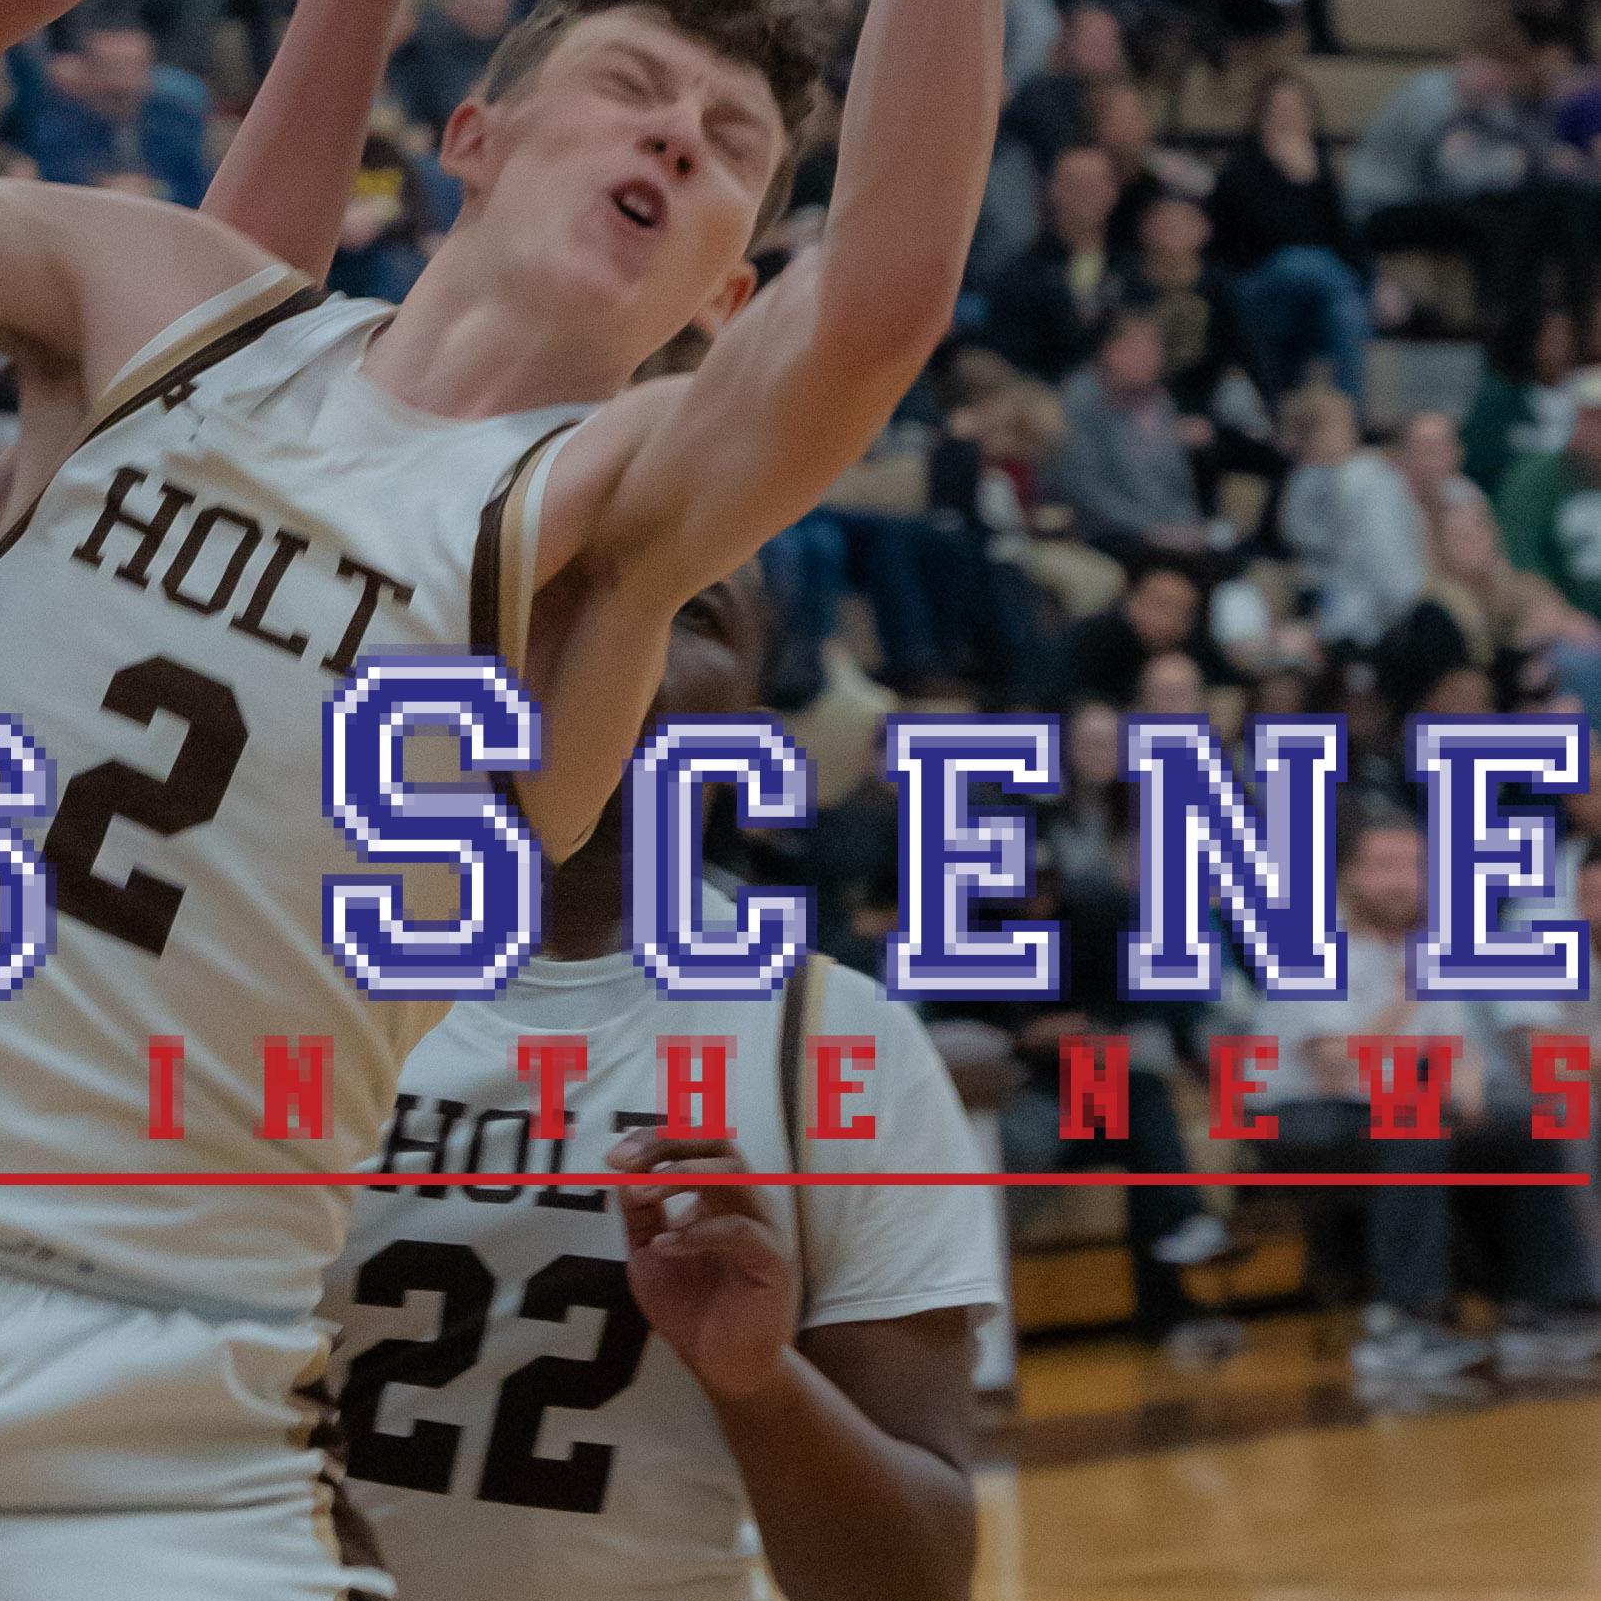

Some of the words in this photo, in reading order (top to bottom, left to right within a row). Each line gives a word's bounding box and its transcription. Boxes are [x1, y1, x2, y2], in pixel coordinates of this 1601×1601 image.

[70, 464, 417, 676] HOLT
[42, 654, 249, 958] 2
[339, 1239, 652, 1515] 22
